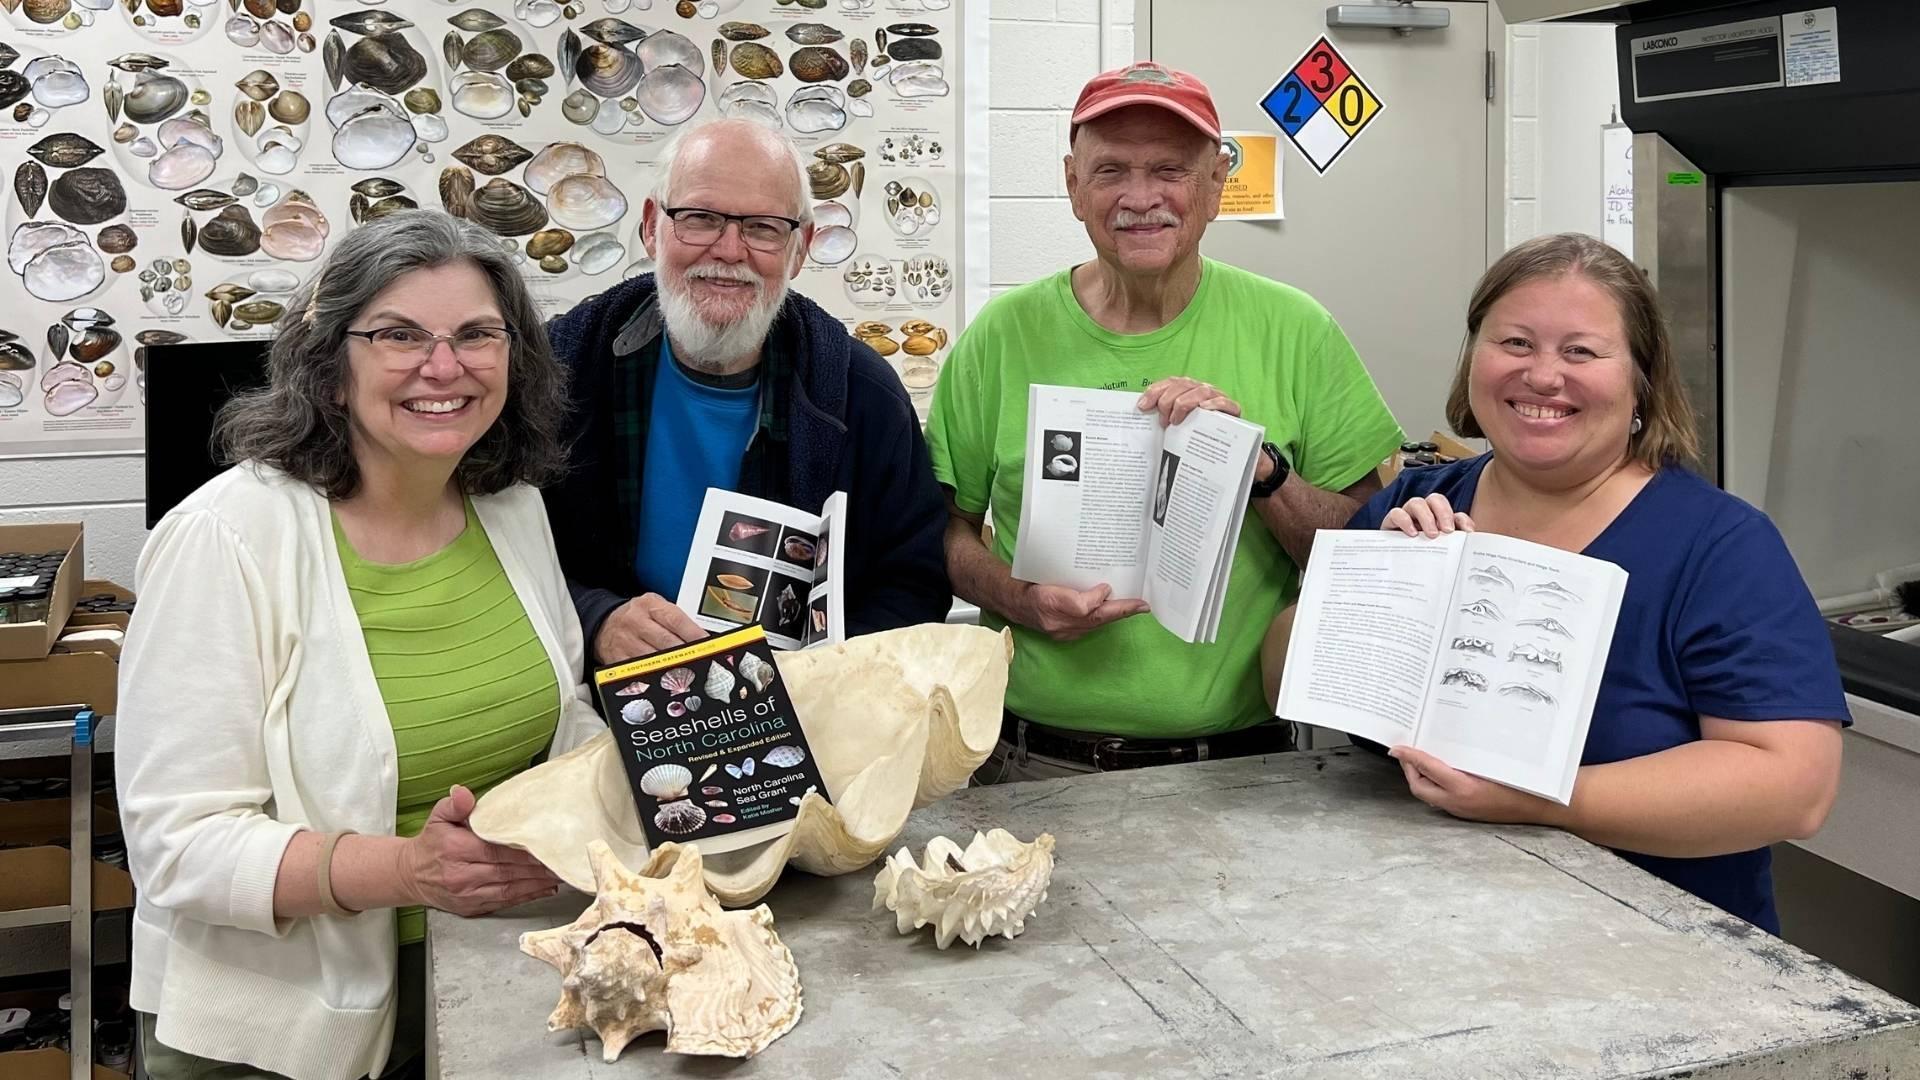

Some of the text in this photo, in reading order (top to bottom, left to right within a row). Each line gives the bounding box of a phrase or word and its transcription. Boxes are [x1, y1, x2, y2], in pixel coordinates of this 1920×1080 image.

[1642, 36, 1678, 51] LABCONCO
[1310, 51, 1336, 94] 3
[1282, 81, 1364, 127] 2 0
[1608, 200, 1623, 212] ID
[626, 658, 661, 673] SOUTHERN
[662, 650, 696, 664] GATEWAYS
[630, 695, 776, 746] Seashells of
[635, 716, 787, 763] North Carolina
[687, 752, 718, 763] Revised
[727, 740, 764, 754] Expanded
[765, 731, 792, 743] Edition
[732, 772, 805, 796] North Carolina
[736, 786, 788, 805] Sea Grant
[740, 804, 761, 814] Edited
